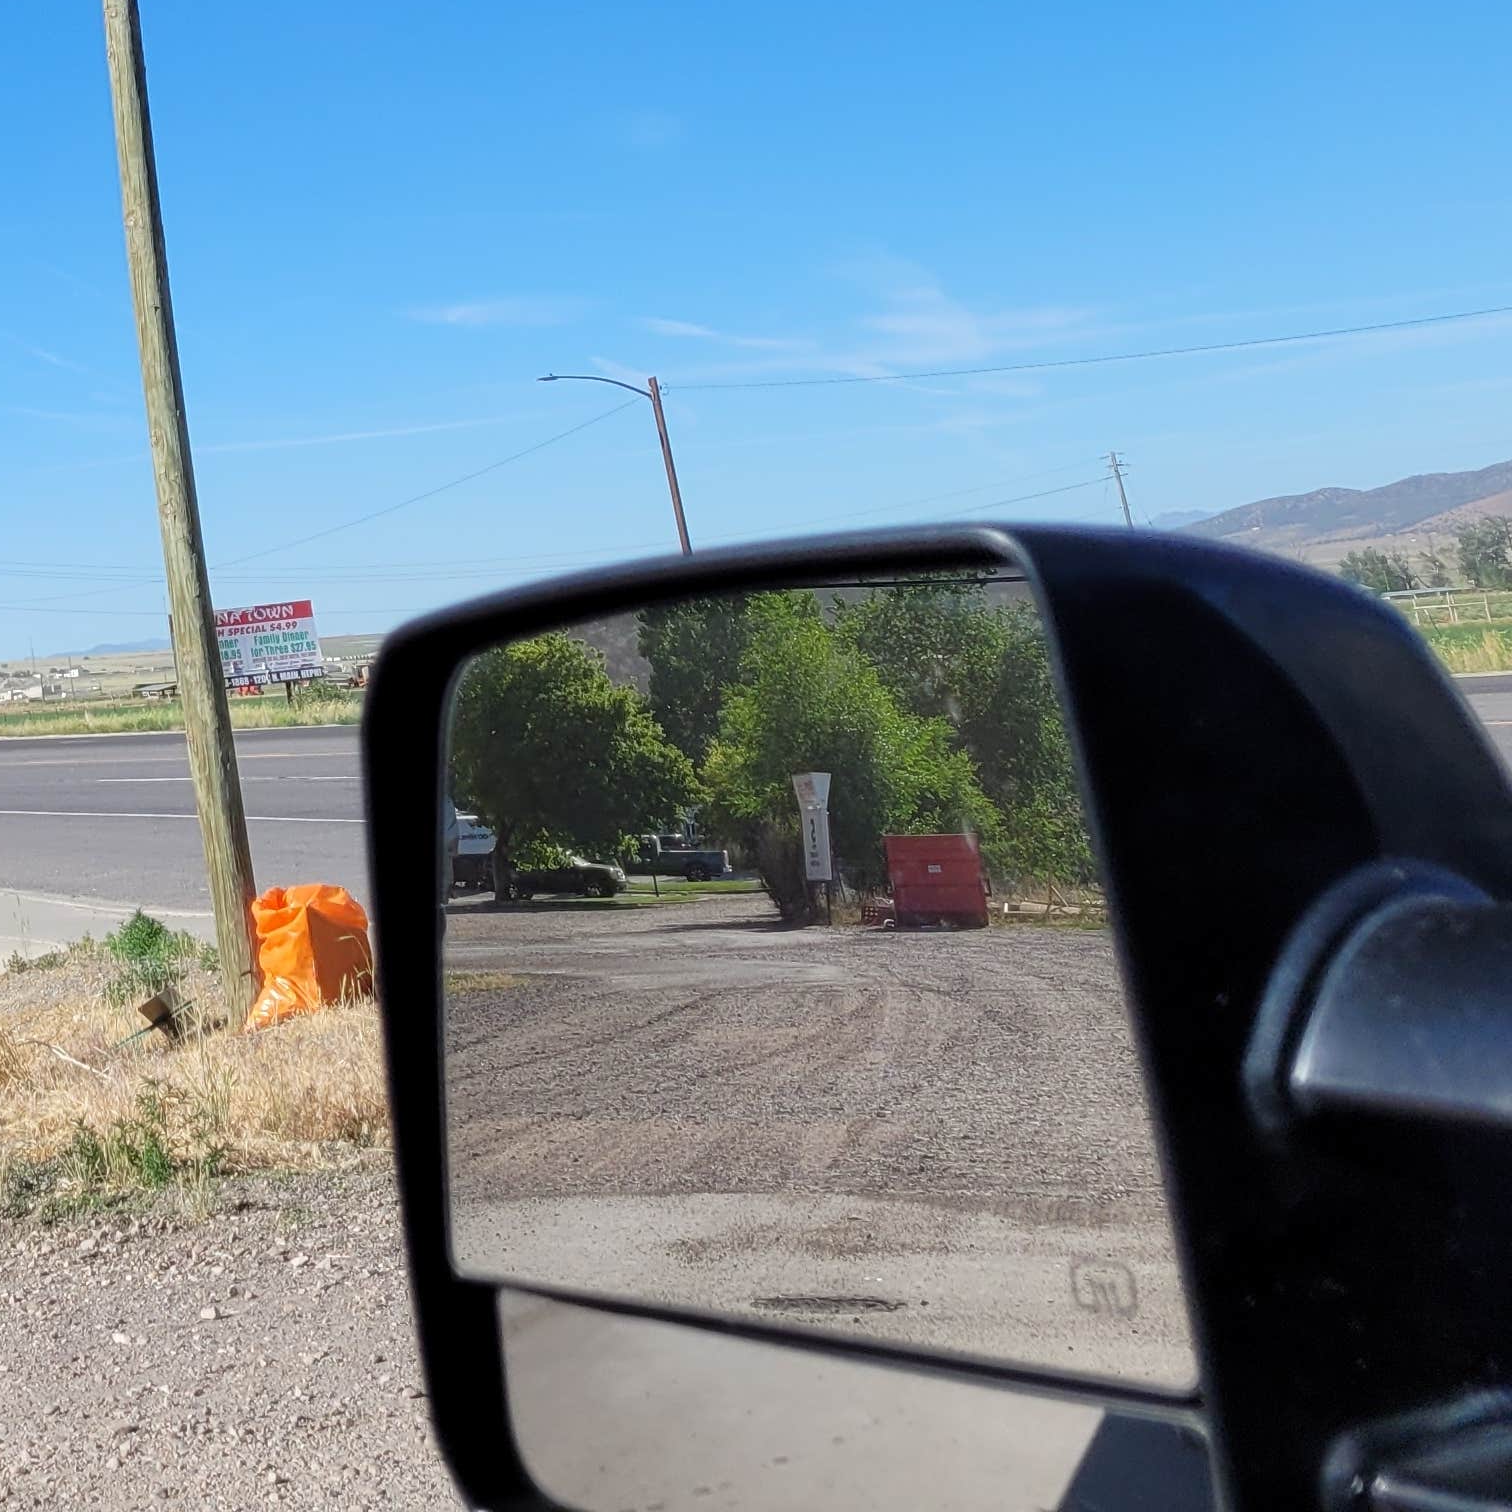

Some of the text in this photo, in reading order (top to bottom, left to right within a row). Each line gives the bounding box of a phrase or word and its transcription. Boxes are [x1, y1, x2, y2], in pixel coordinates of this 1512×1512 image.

[216, 605, 294, 625] NA TOWN
[228, 624, 266, 637] SPECIAL
[254, 631, 309, 646] Family Dinner
[265, 644, 289, 656] Three
